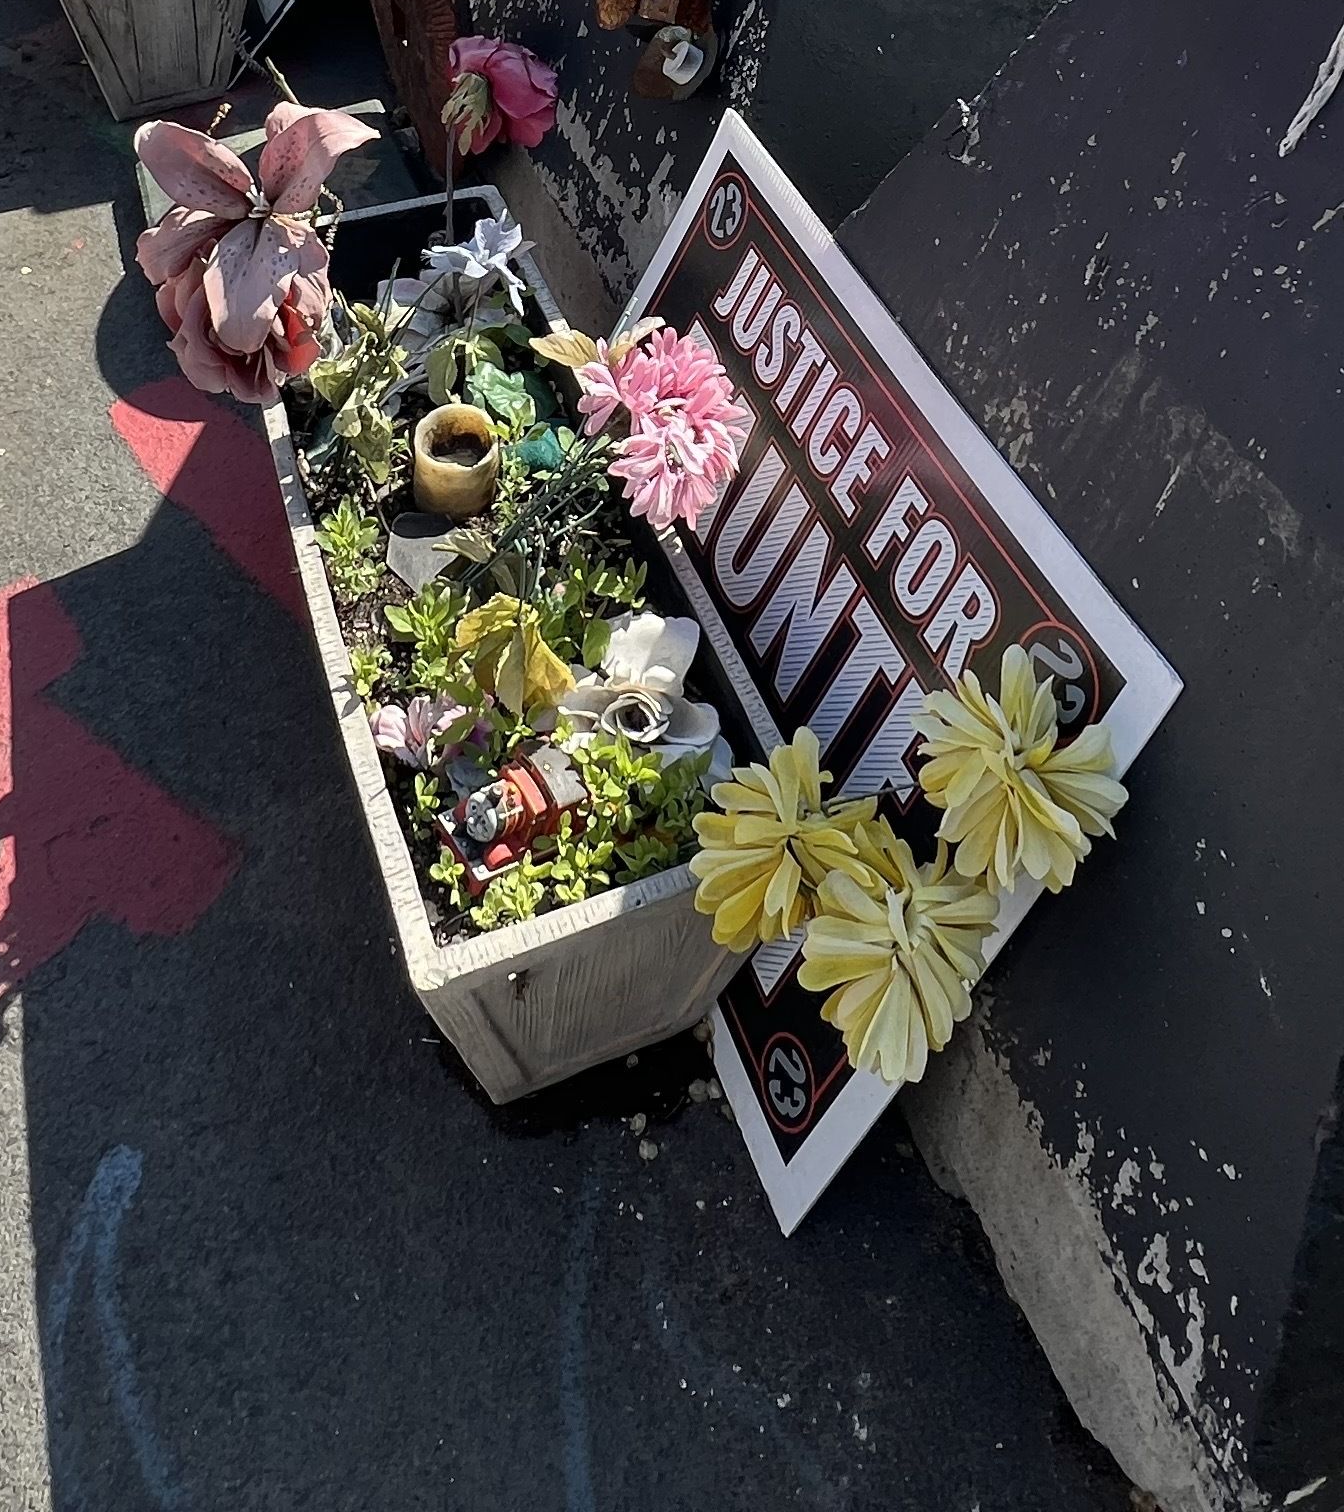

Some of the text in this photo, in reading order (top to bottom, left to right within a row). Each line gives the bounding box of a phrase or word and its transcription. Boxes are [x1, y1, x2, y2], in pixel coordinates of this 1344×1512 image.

[709, 182, 742, 238] 23
[715, 248, 890, 519] JUSTICE
[686, 320, 928, 806] UNTE
[866, 475, 997, 687] FOR
[768, 1046, 807, 1120] 23
